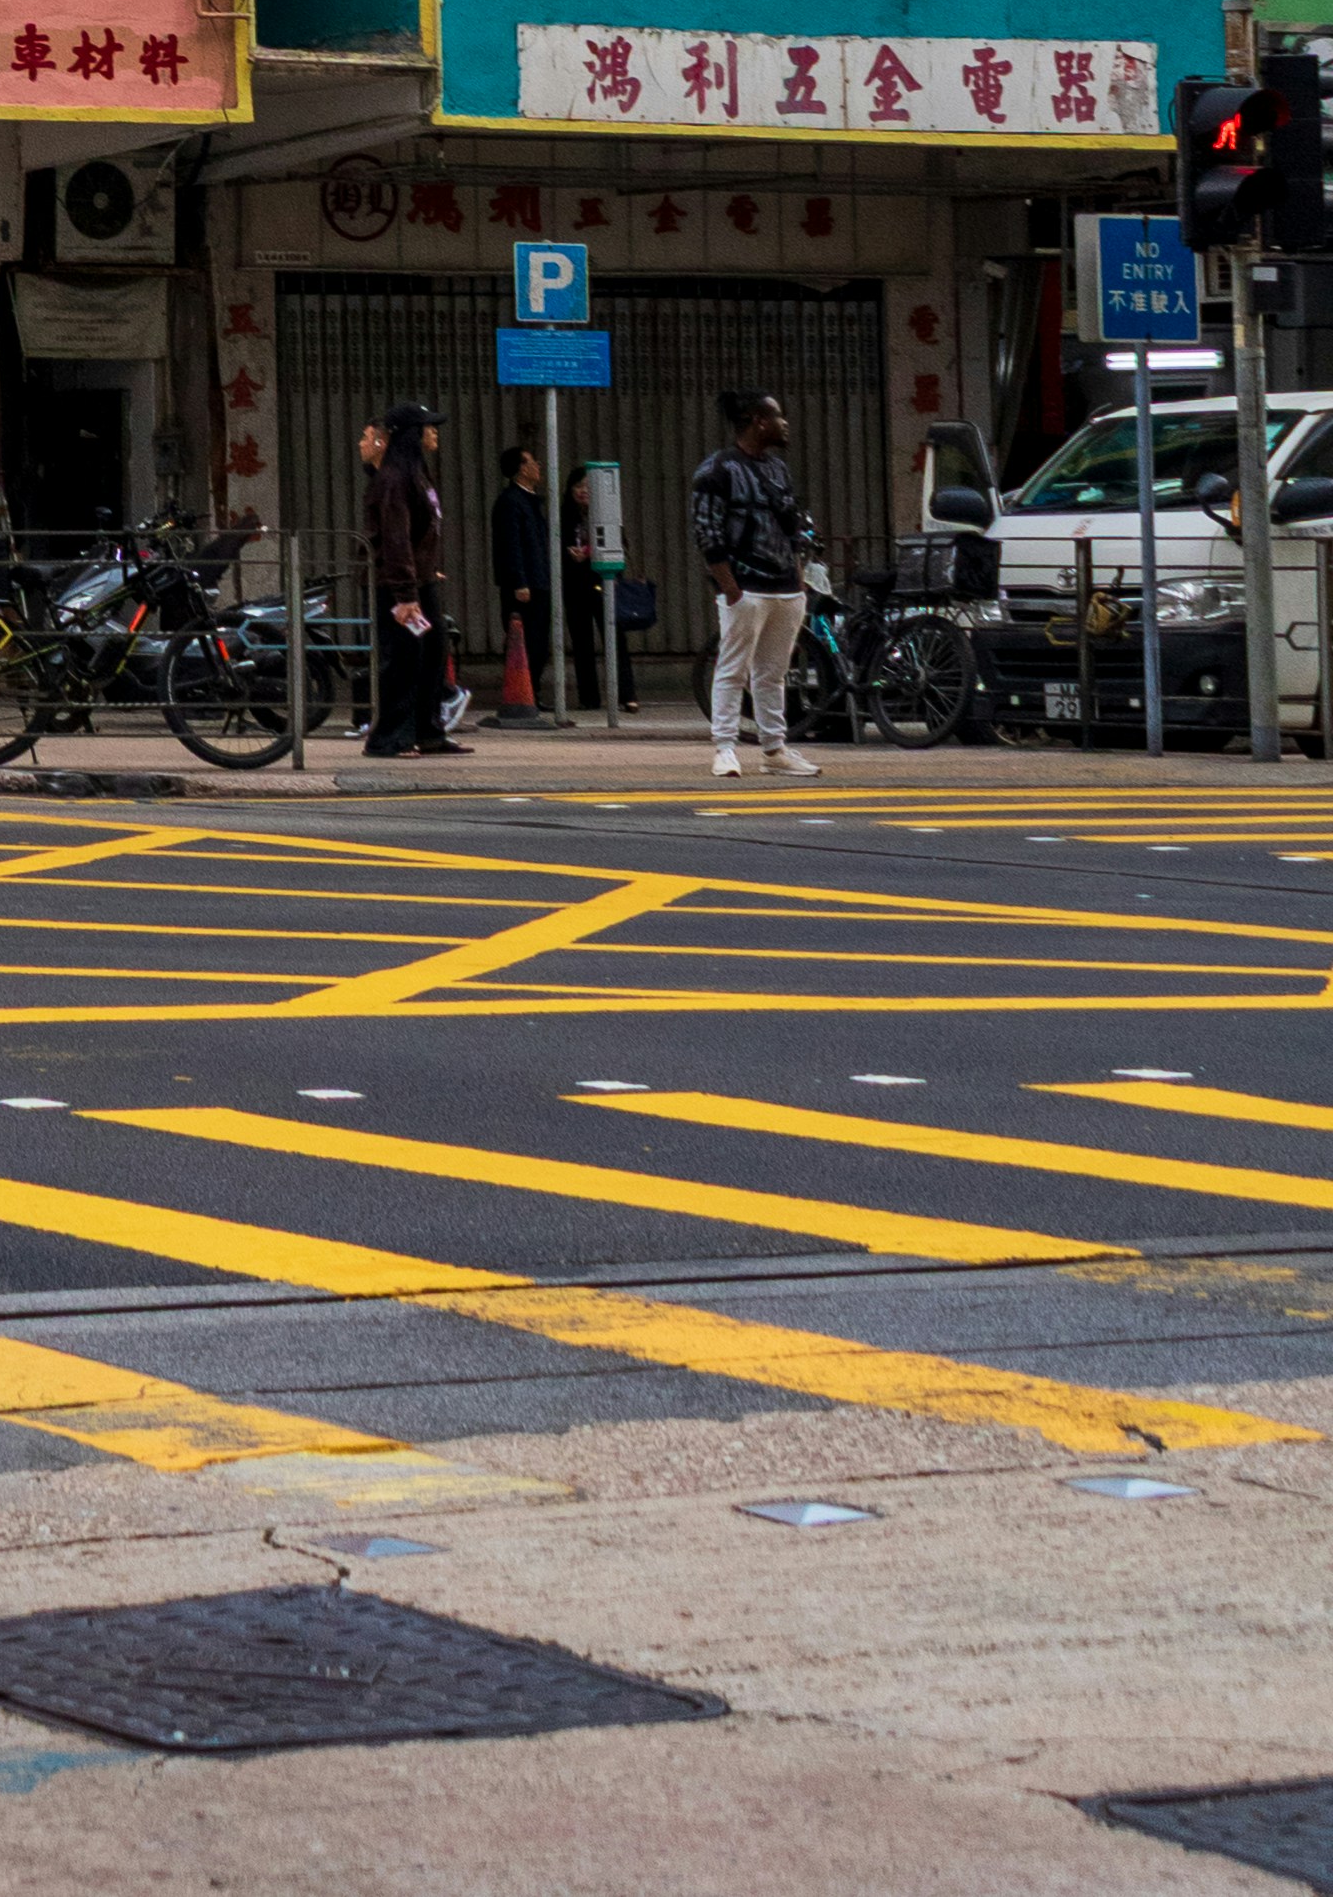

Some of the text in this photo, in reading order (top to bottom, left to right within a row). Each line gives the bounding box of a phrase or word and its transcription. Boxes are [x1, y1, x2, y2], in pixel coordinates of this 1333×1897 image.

[583, 35, 1097, 124] 鴻利五金電器
[1136, 242, 1160, 259] NO
[528, 251, 574, 313] P
[1122, 263, 1174, 281] ENTRY
[1108, 290, 1192, 315] 不准駛入
